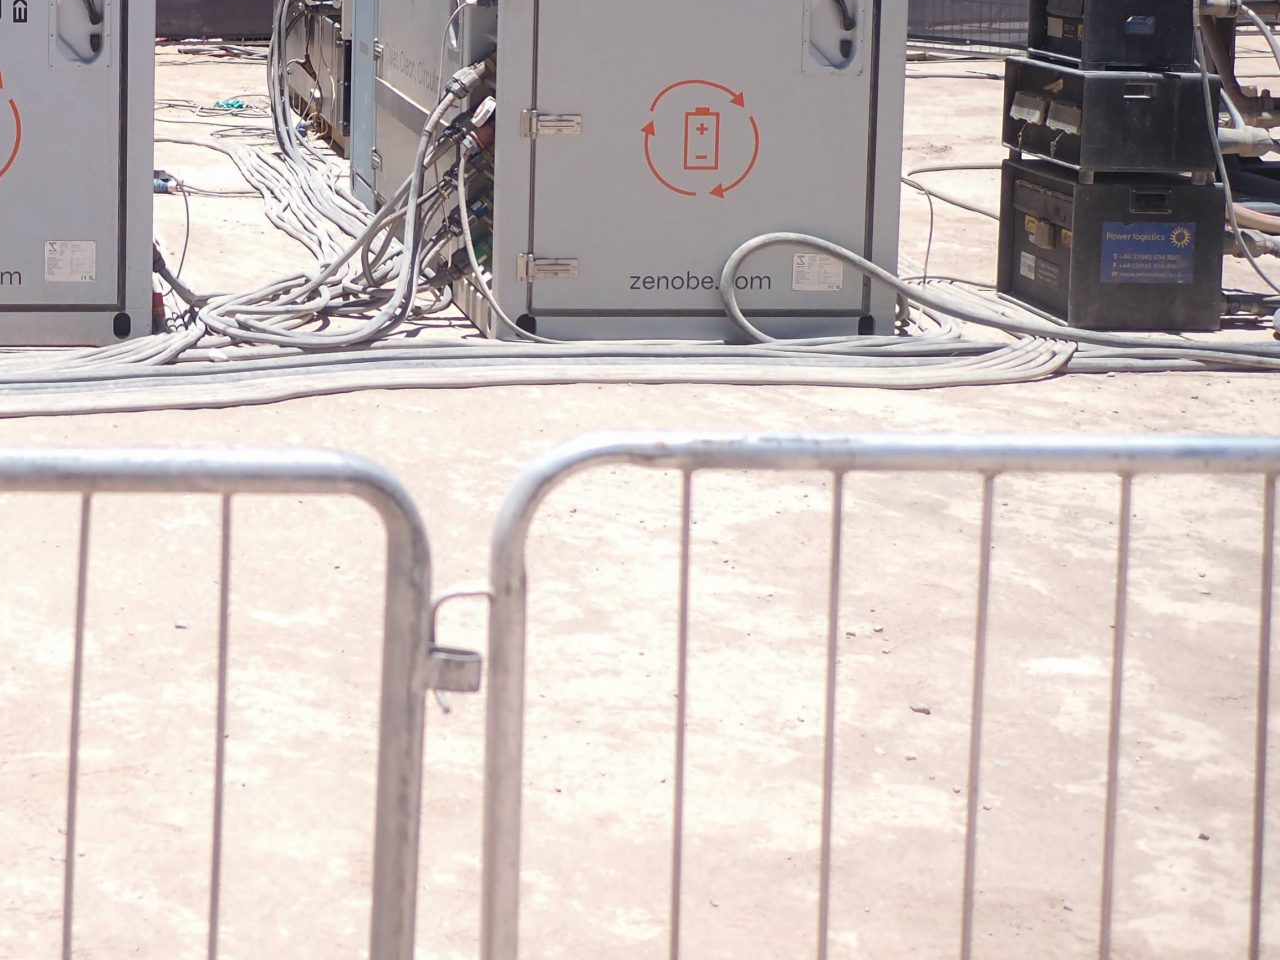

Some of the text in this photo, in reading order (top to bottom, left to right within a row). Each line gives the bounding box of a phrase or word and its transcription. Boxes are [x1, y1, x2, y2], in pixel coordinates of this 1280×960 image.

[1106, 232, 1165, 242] Power logistics
[629, 271, 772, 291] zenobe.om
